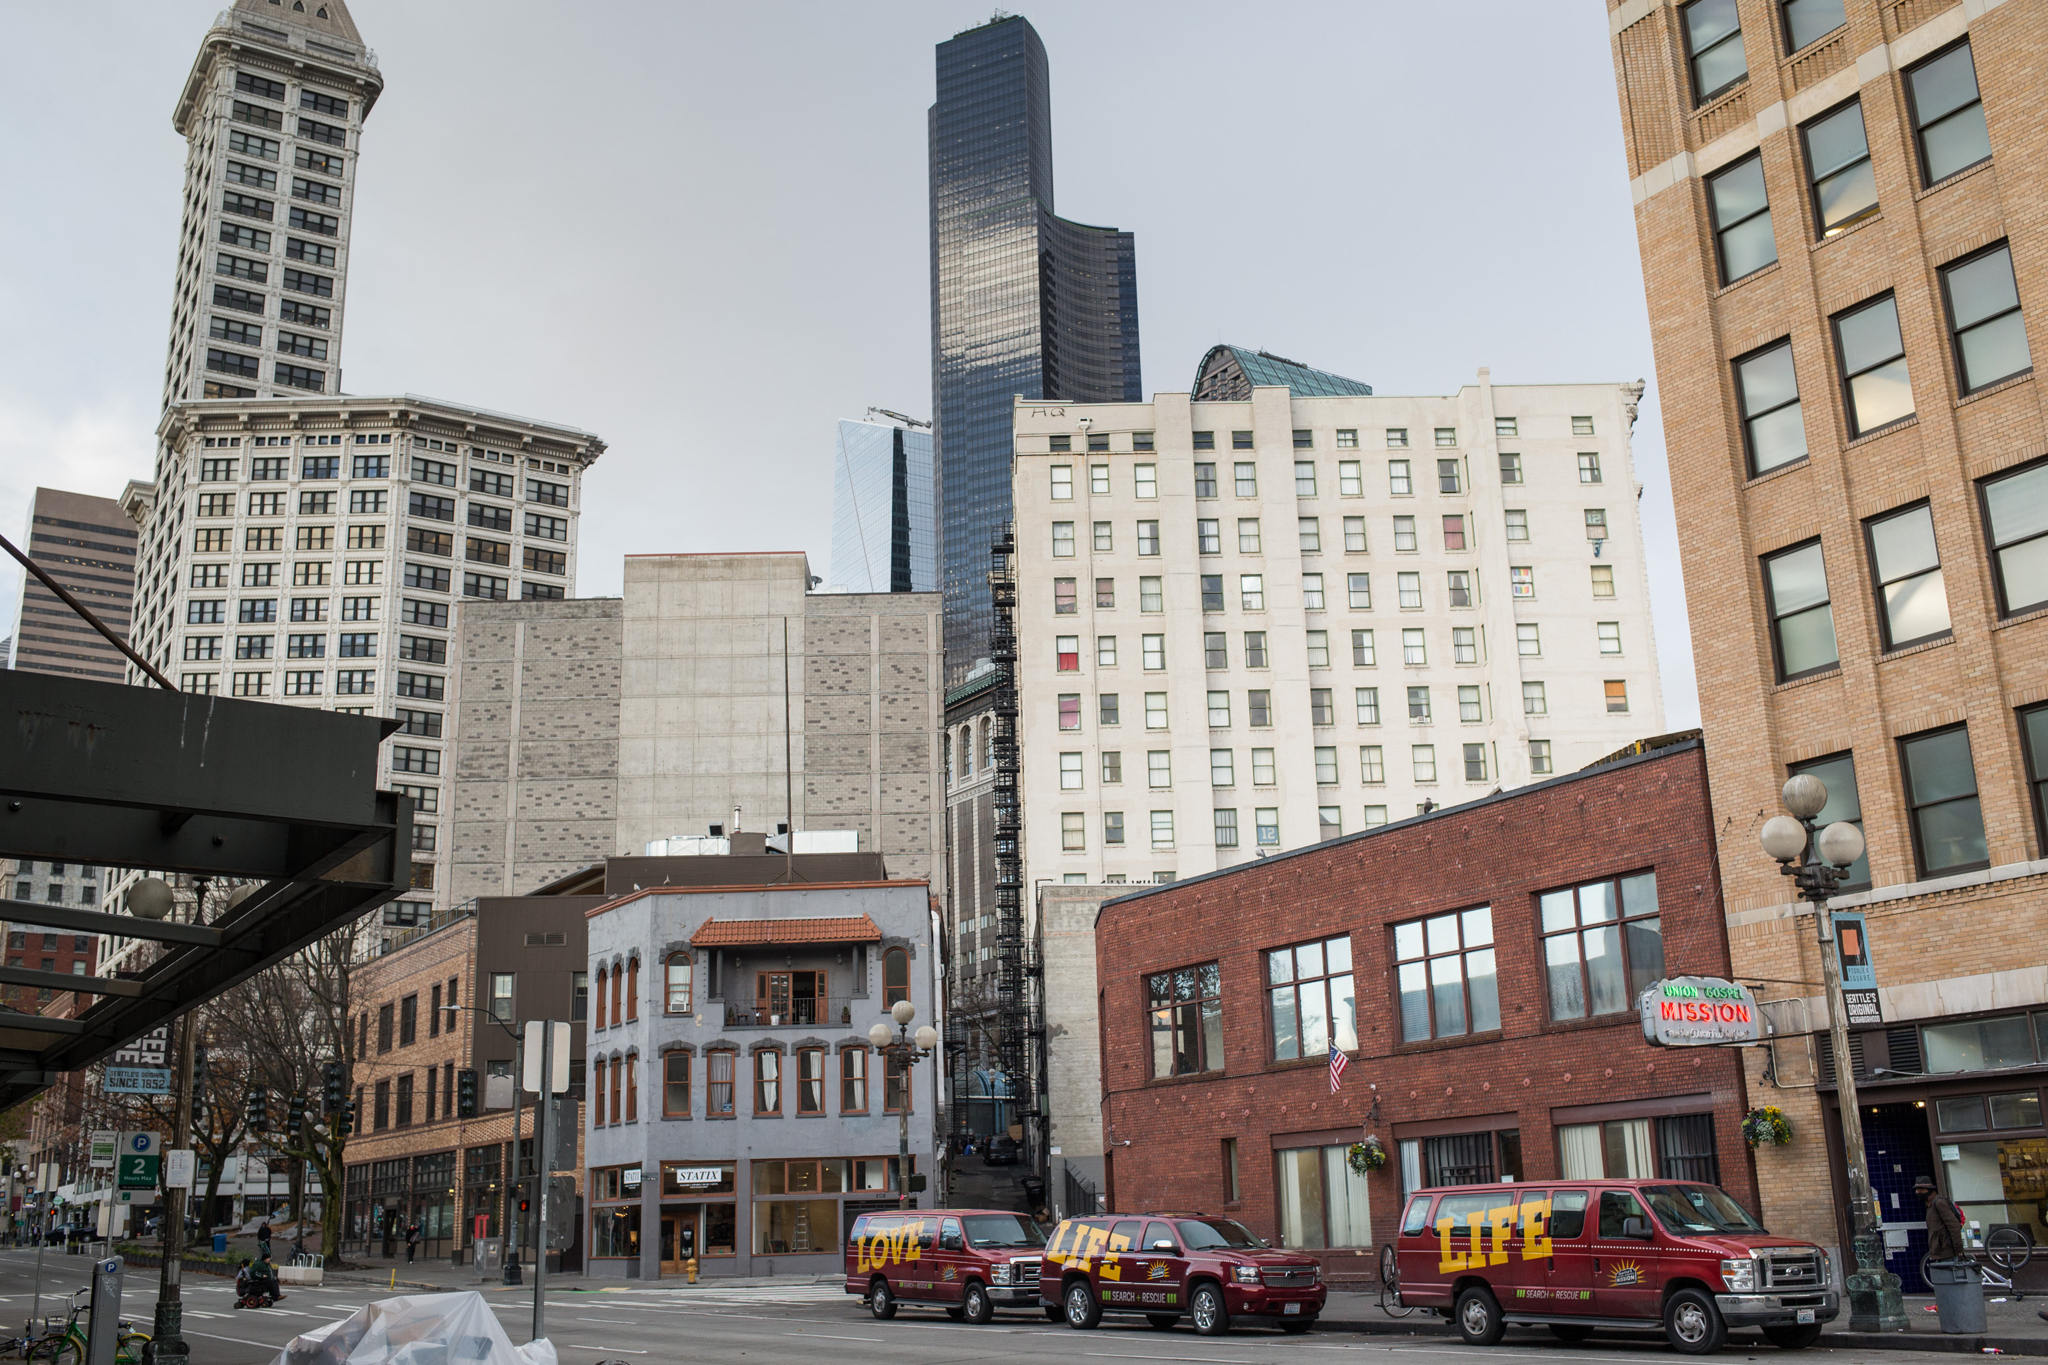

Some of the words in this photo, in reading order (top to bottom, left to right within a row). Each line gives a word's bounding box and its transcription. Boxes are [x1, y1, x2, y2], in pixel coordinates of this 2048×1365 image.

[1261, 827, 1275, 840] 12
[46, 875, 98, 887] ALASKA
[1663, 986, 1698, 998] UNION
[1704, 987, 1745, 999] GOSPEL
[1846, 993, 1877, 1004] SEATTLE'S
[1661, 1001, 1752, 1022] MISSION
[1848, 1003, 1879, 1016] ORIGINAL
[109, 1077, 139, 1088] SINCE
[141, 1079, 165, 1089] 1852
[137, 1137, 147, 1148] P
[132, 1158, 146, 1174] 2
[680, 1171, 719, 1181] STATIX
[1437, 1198, 1553, 1274] LIFE
[857, 1220, 925, 1274] LOVE
[1047, 1220, 1131, 1282] LIFE
[1112, 1291, 1135, 1301] SEARCH
[1142, 1292, 1166, 1303] RESCUE
[1526, 1289, 1549, 1299] SEARCH
[1555, 1290, 1579, 1300] RESCUE
